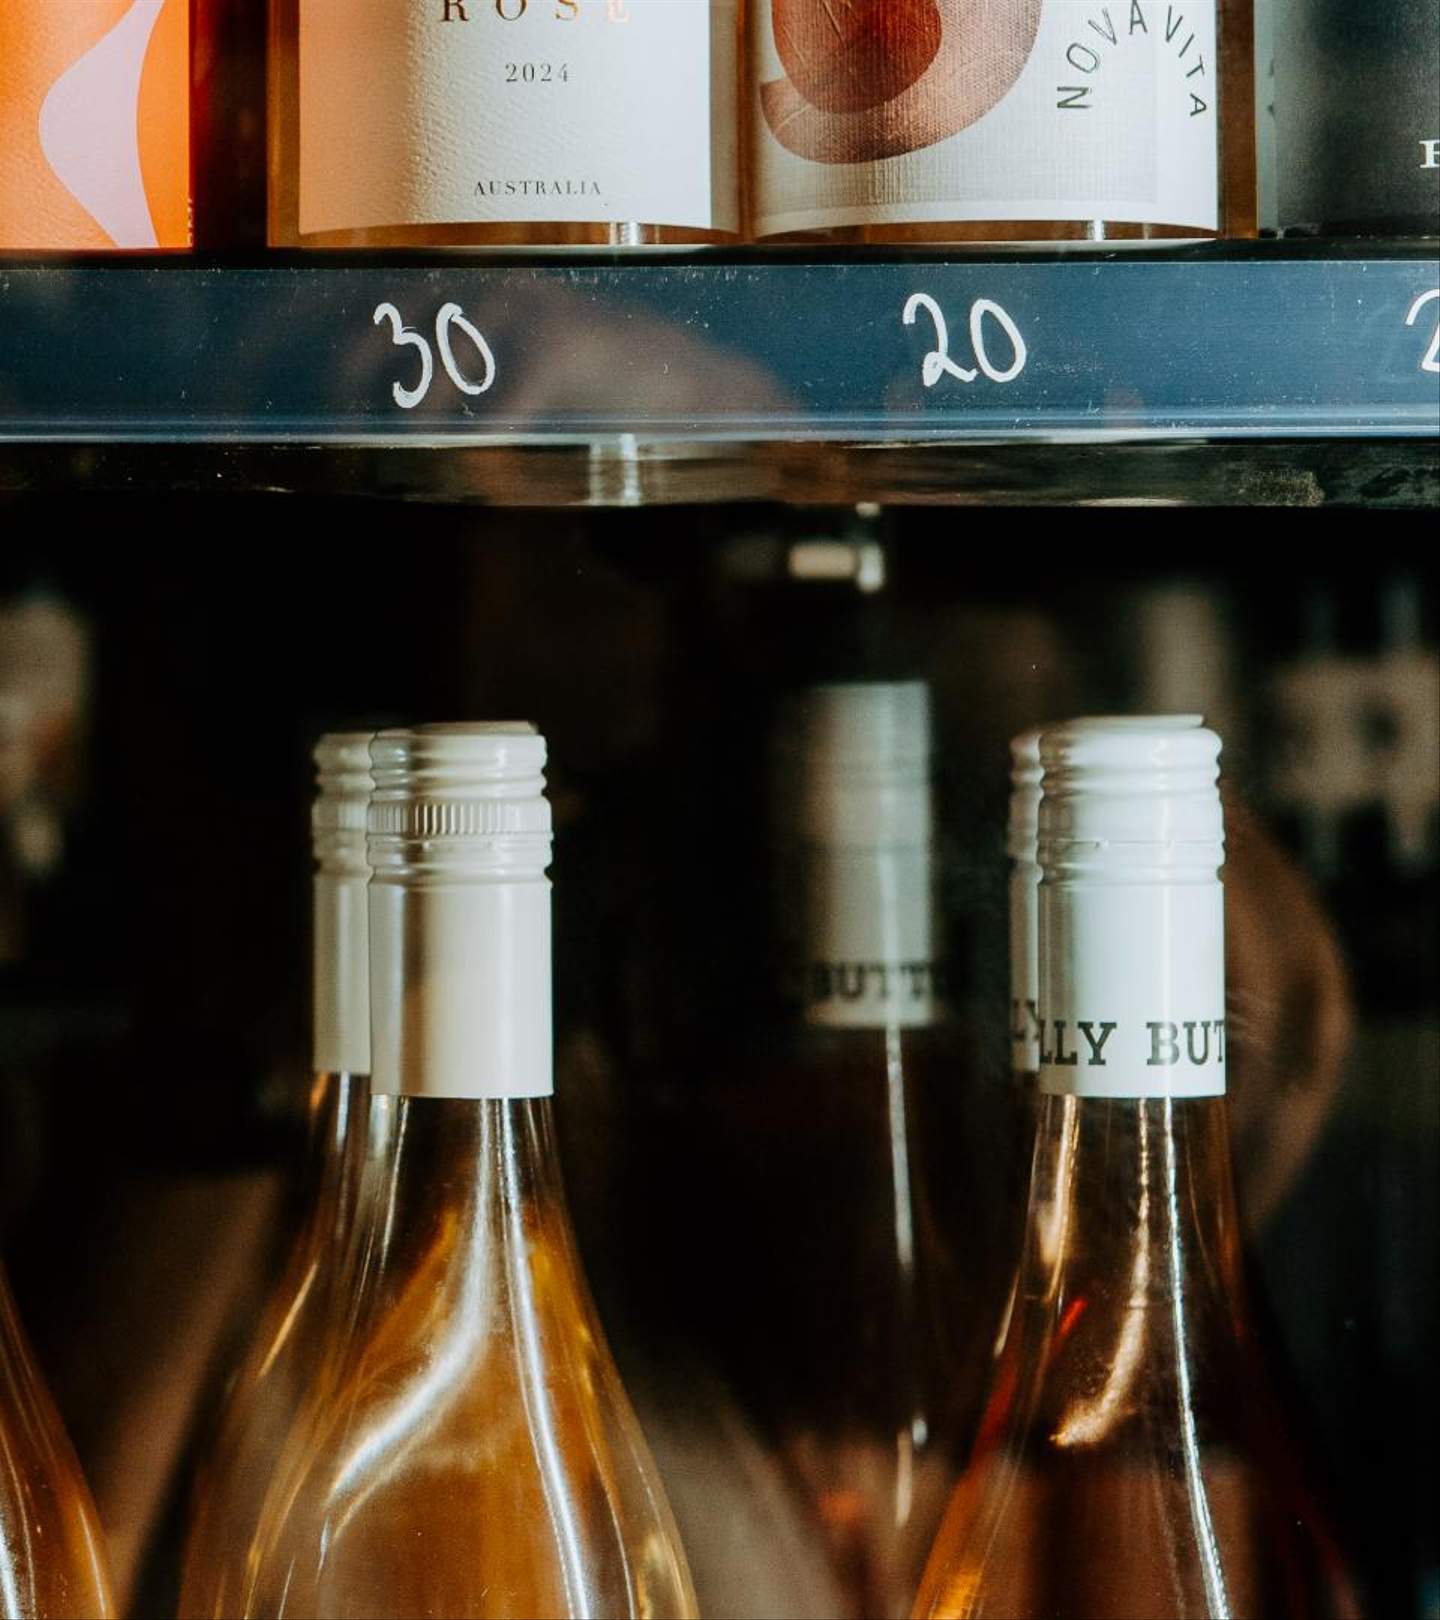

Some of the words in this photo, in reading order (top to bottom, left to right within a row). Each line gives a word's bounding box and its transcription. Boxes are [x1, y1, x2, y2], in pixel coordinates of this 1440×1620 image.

[504, 62, 570, 83] 2024
[1056, 0, 1208, 117] NOVAVITA
[473, 180, 602, 196] AUSTRALIA
[373, 301, 496, 409] 30
[903, 293, 1027, 387] 20
